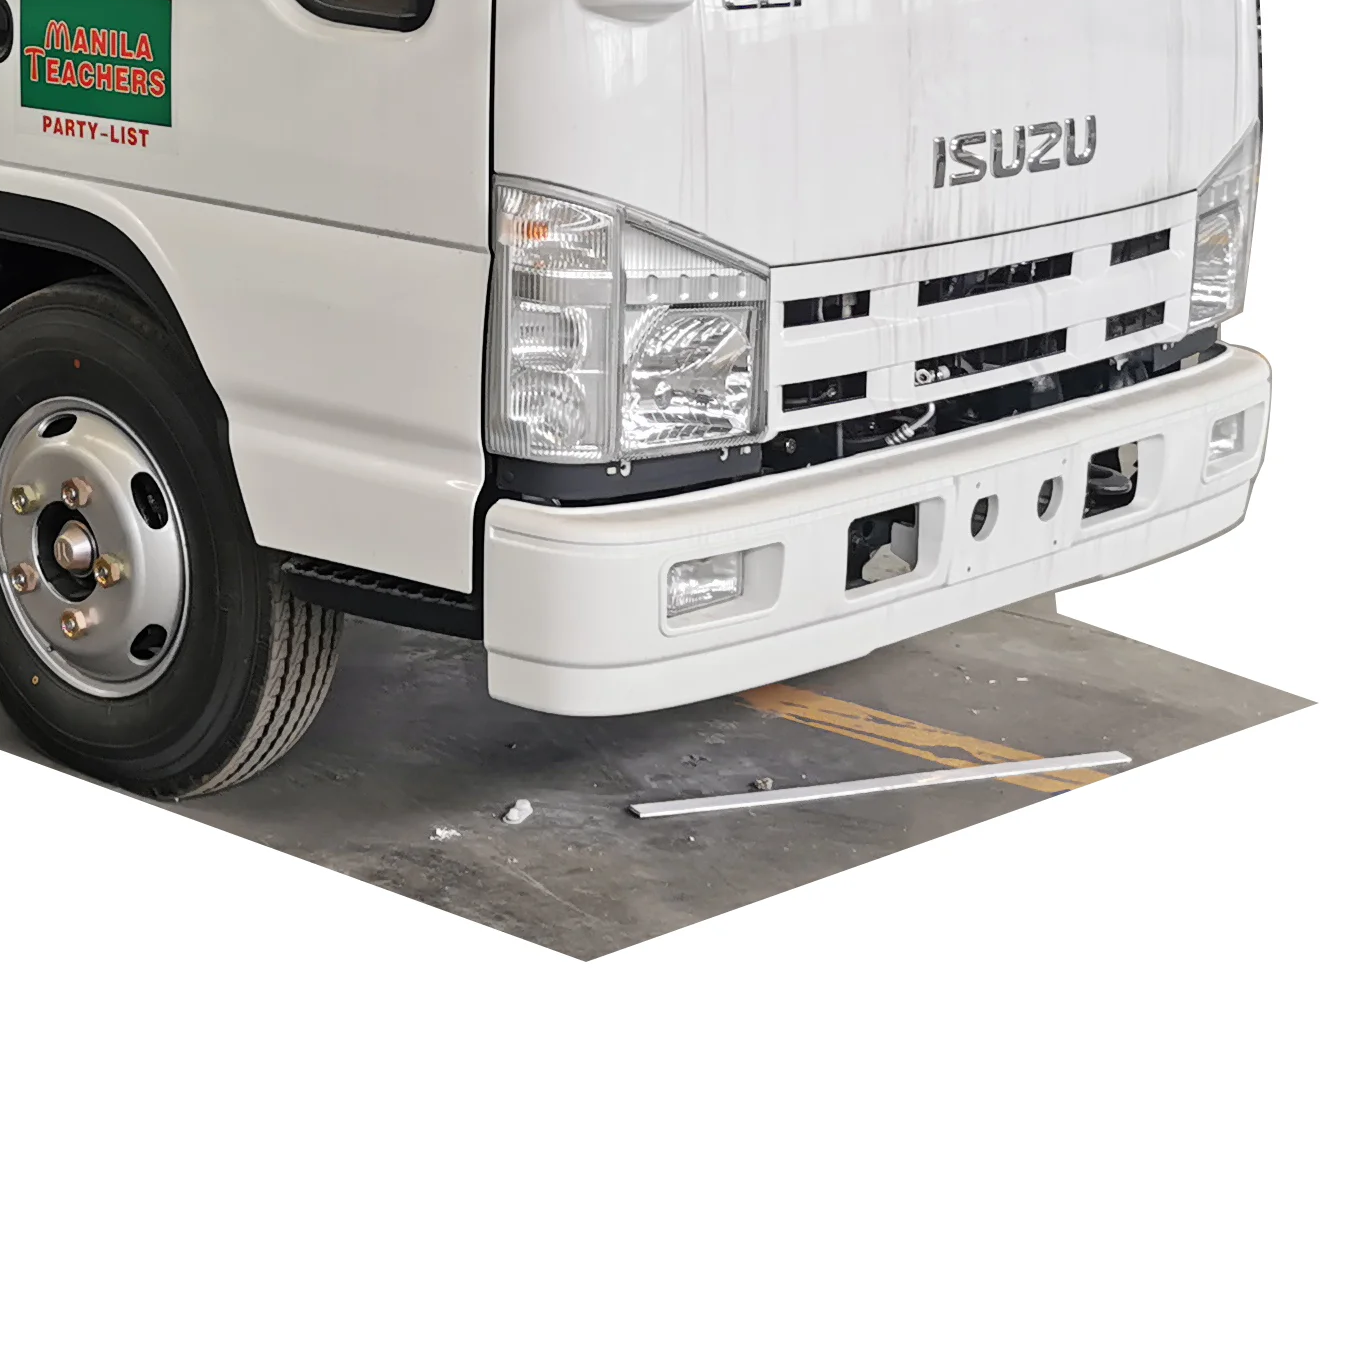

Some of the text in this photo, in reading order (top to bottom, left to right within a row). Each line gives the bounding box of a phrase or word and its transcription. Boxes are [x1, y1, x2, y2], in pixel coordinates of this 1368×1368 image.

[44, 19, 154, 62] MANILA
[24, 46, 166, 98] TEACHERS
[42, 115, 150, 148] PARTY-LIST
[932, 114, 1096, 189] ISUZU
